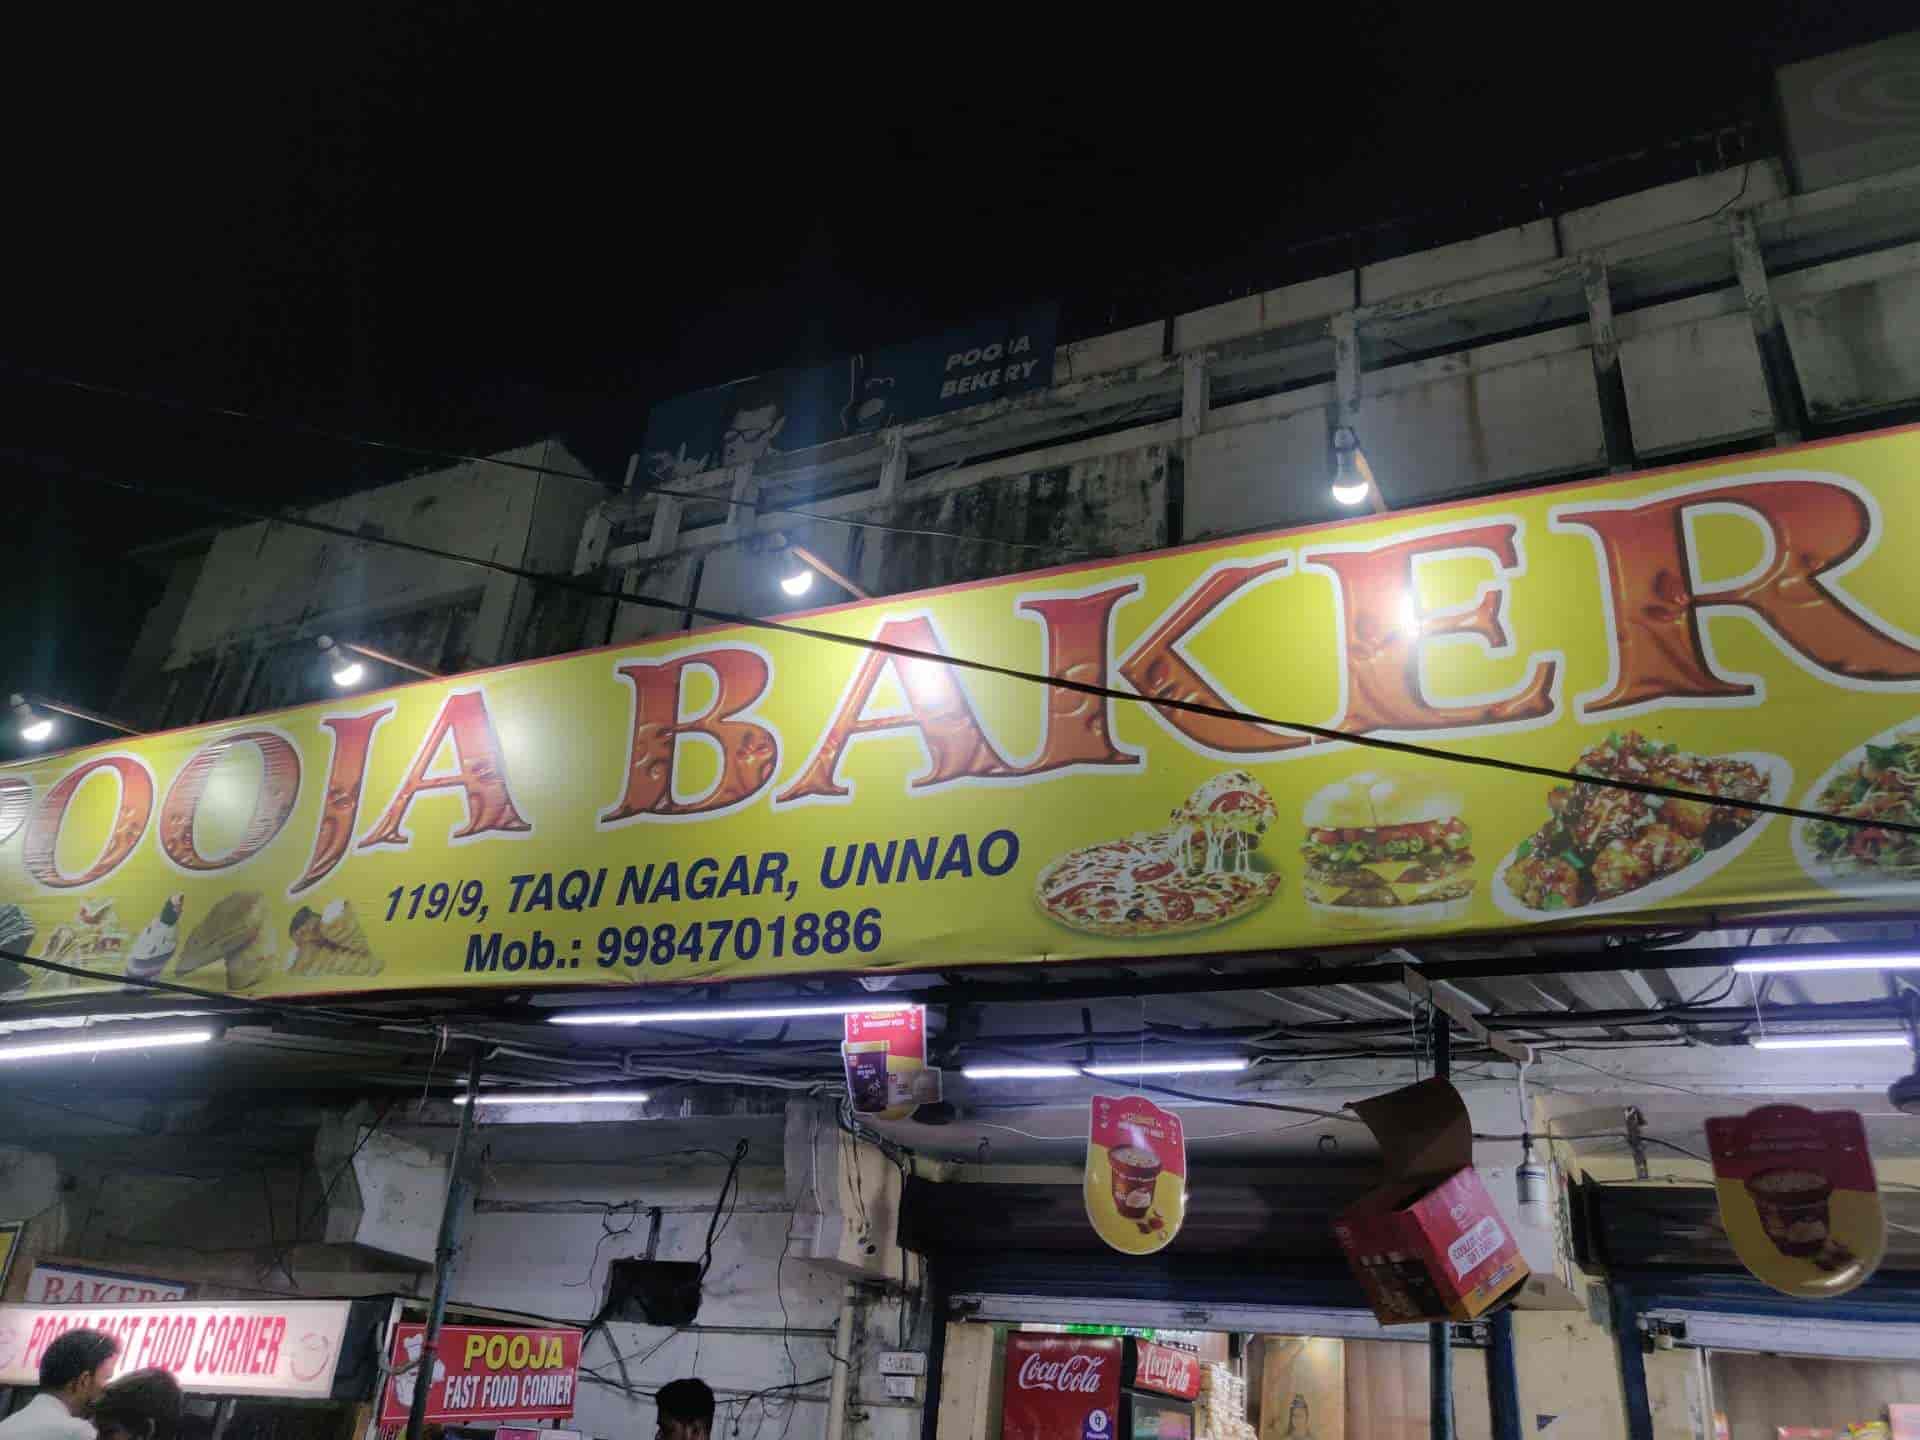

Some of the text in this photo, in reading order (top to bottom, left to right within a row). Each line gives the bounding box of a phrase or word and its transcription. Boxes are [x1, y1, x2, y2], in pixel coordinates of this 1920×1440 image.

[383, 829, 1020, 923] 119/9, TAQI NAGAR, UNNAO
[463, 907, 882, 972] Mob.: 9984701886
[135, 1315, 197, 1374] FOOD
[193, 1315, 287, 1375] CORNER
[463, 1334, 565, 1370] POOJA
[443, 1373, 573, 1409] FAST FOOD CORNER
